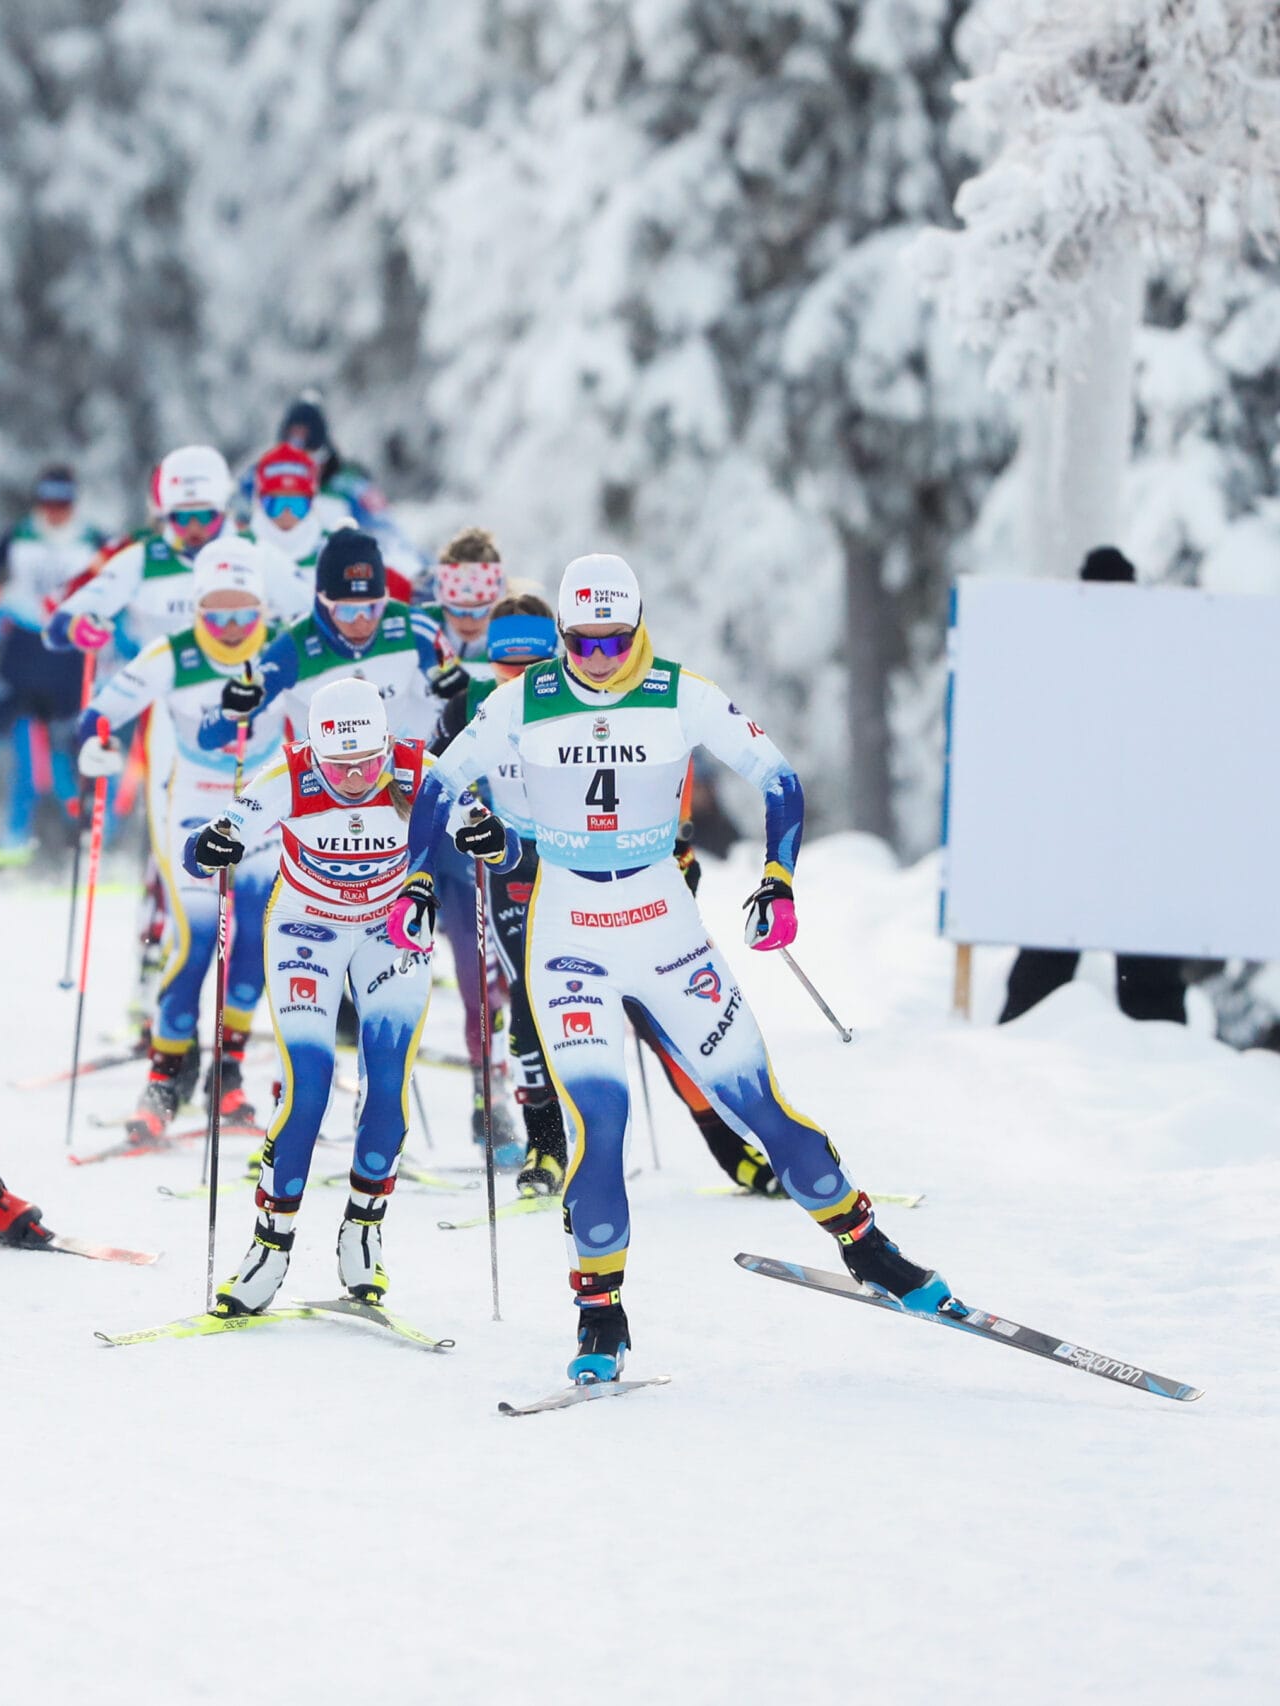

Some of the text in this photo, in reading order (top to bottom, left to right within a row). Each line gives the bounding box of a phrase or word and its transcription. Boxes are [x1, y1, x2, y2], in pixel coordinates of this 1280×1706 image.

[594, 589, 629, 599] SVENSKA
[594, 596, 614, 604] SPEL
[537, 686, 557, 695] coop
[643, 681, 668, 691] coop
[338, 719, 371, 728] SVENSKA
[558, 745, 647, 764] VELTINS
[303, 785, 320, 794] coop
[585, 768, 620, 813] 4
[535, 823, 590, 849] SNOW
[616, 821, 673, 849] SNOW
[317, 836, 397, 852] VELTINS
[302, 850, 406, 877] coop
[307, 870, 332, 885] CROSS
[332, 881, 369, 889] COUNTRY
[370, 870, 396, 886] WORLD
[571, 899, 668, 928] BAUHAUS
[288, 923, 327, 940] Ford
[555, 958, 596, 974] Ford
[655, 944, 710, 975] Sundström
[277, 960, 330, 977] SCANIA
[367, 951, 420, 994] CRAT
[683, 977, 713, 997] Thermia
[280, 1004, 312, 1014] SVENSKA
[548, 995, 603, 1009] SCANIA
[699, 996, 739, 1057] CRAFT
[554, 1037, 608, 1051] SVENSKA SPEL
[222, 1318, 248, 1330] FISCHER
